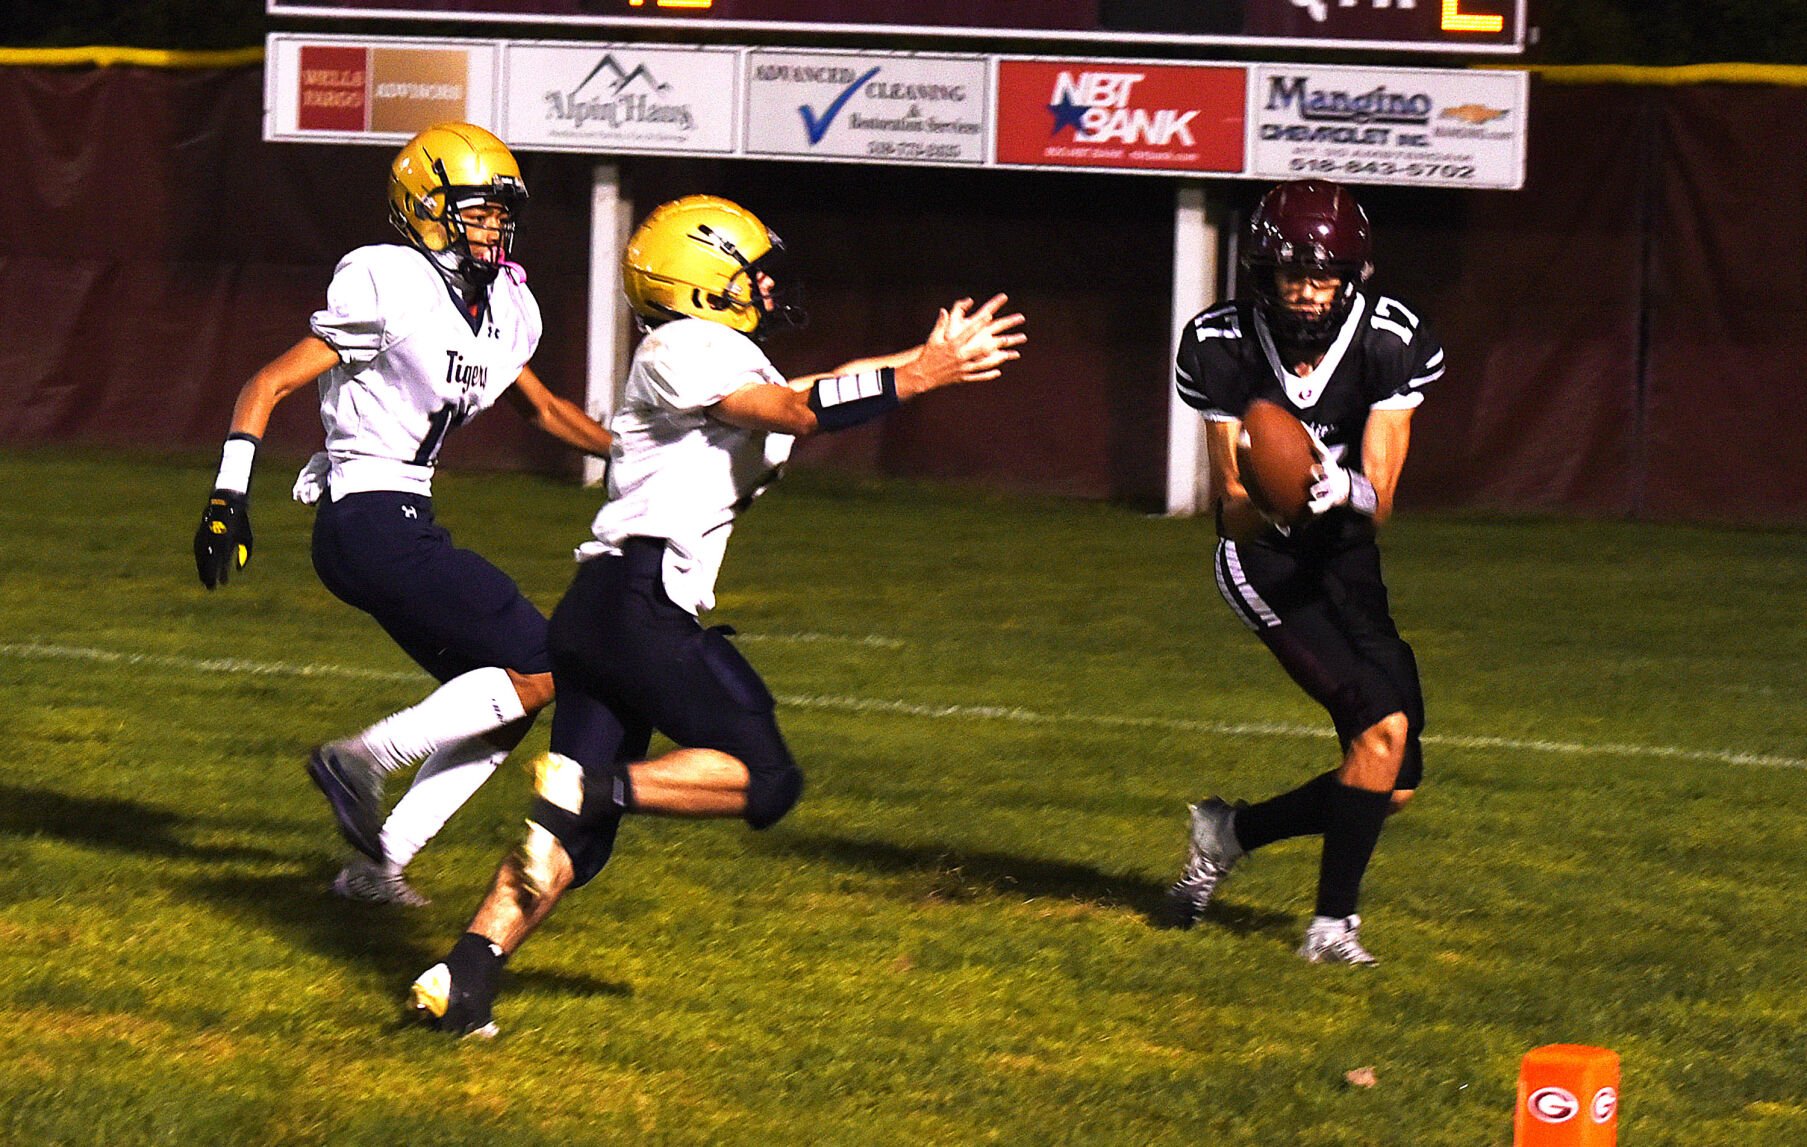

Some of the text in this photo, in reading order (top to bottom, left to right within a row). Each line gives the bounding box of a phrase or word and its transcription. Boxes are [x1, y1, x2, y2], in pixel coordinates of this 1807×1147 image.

[302, 69, 366, 87] WELLS
[755, 65, 857, 83] ADVANCED
[865, 82, 967, 102] CLEANING
[1050, 71, 1146, 108] NBT
[1265, 76, 1432, 124] Mangino
[1073, 107, 1202, 147] BANK
[1260, 124, 1391, 144] CHEVROLET
[1371, 296, 1419, 345] 17
